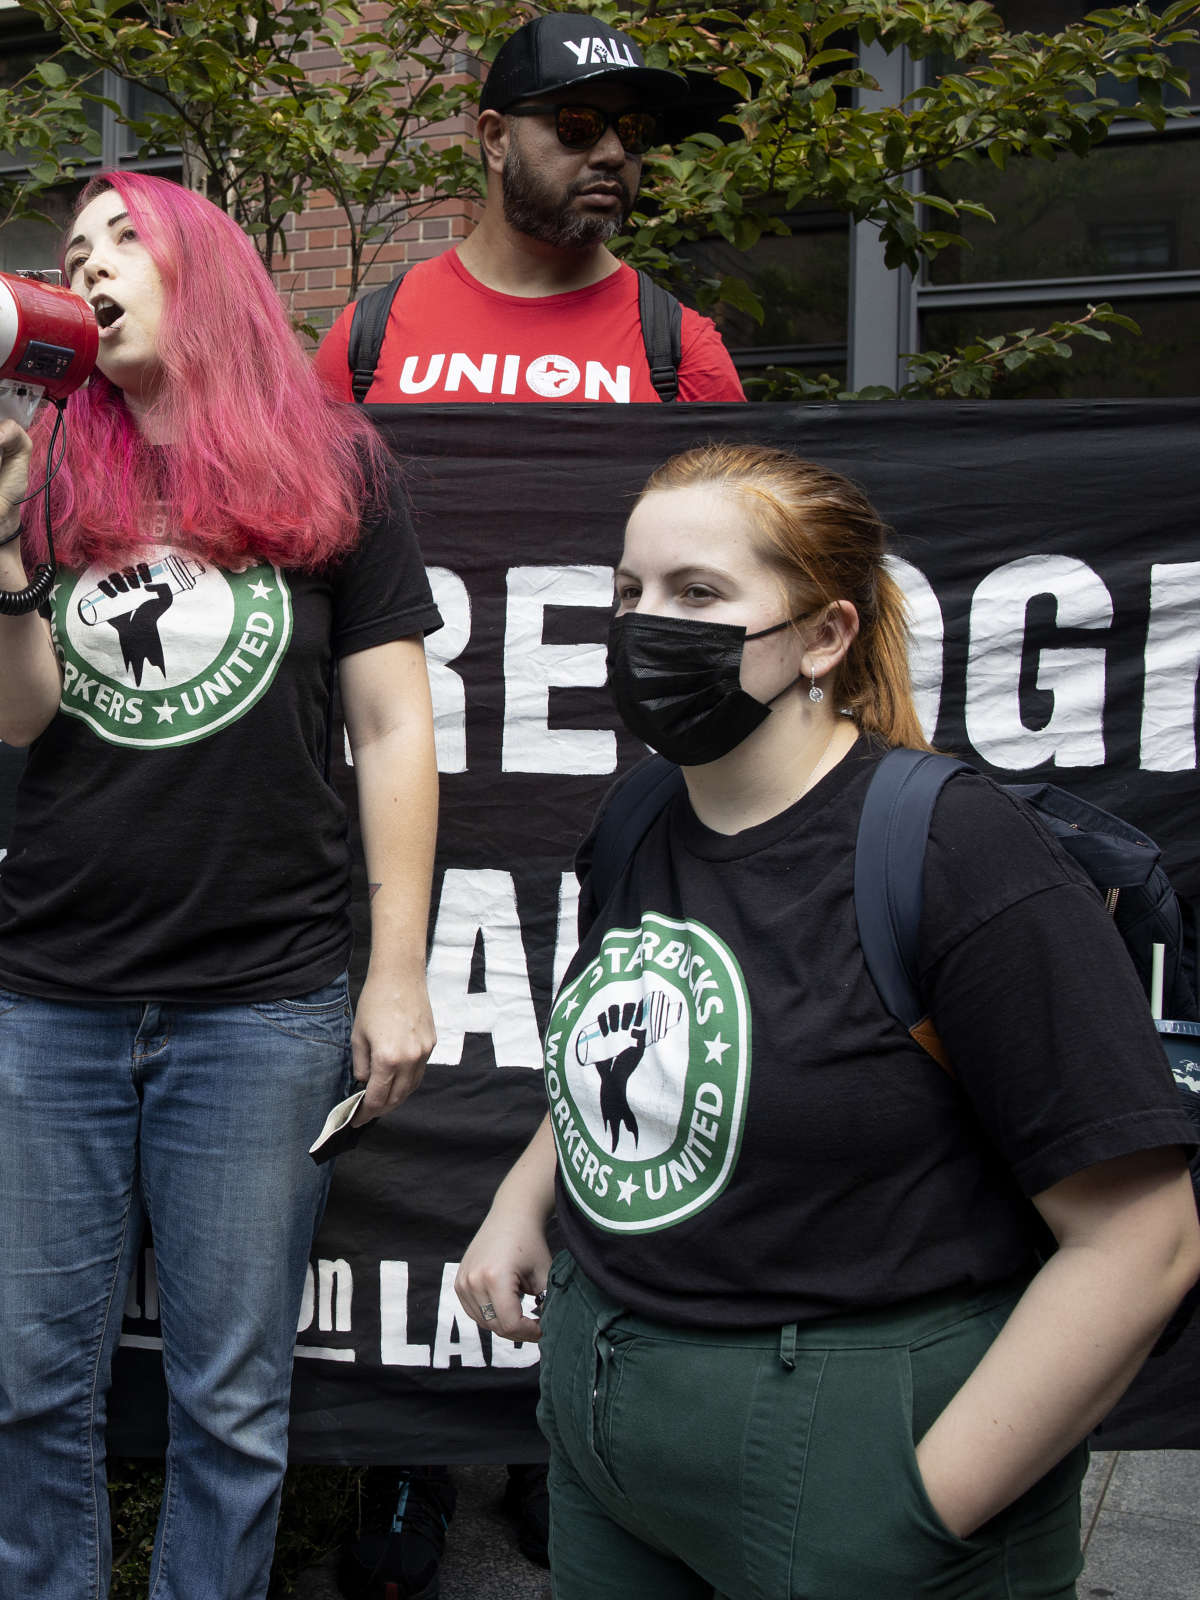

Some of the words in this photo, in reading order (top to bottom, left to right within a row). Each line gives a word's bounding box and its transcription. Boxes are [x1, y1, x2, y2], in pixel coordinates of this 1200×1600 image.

[399, 352, 631, 404] UNION
[180, 611, 274, 716] UNITED
[546, 1031, 613, 1198] WORKERS
[644, 1082, 723, 1200] UNITED
